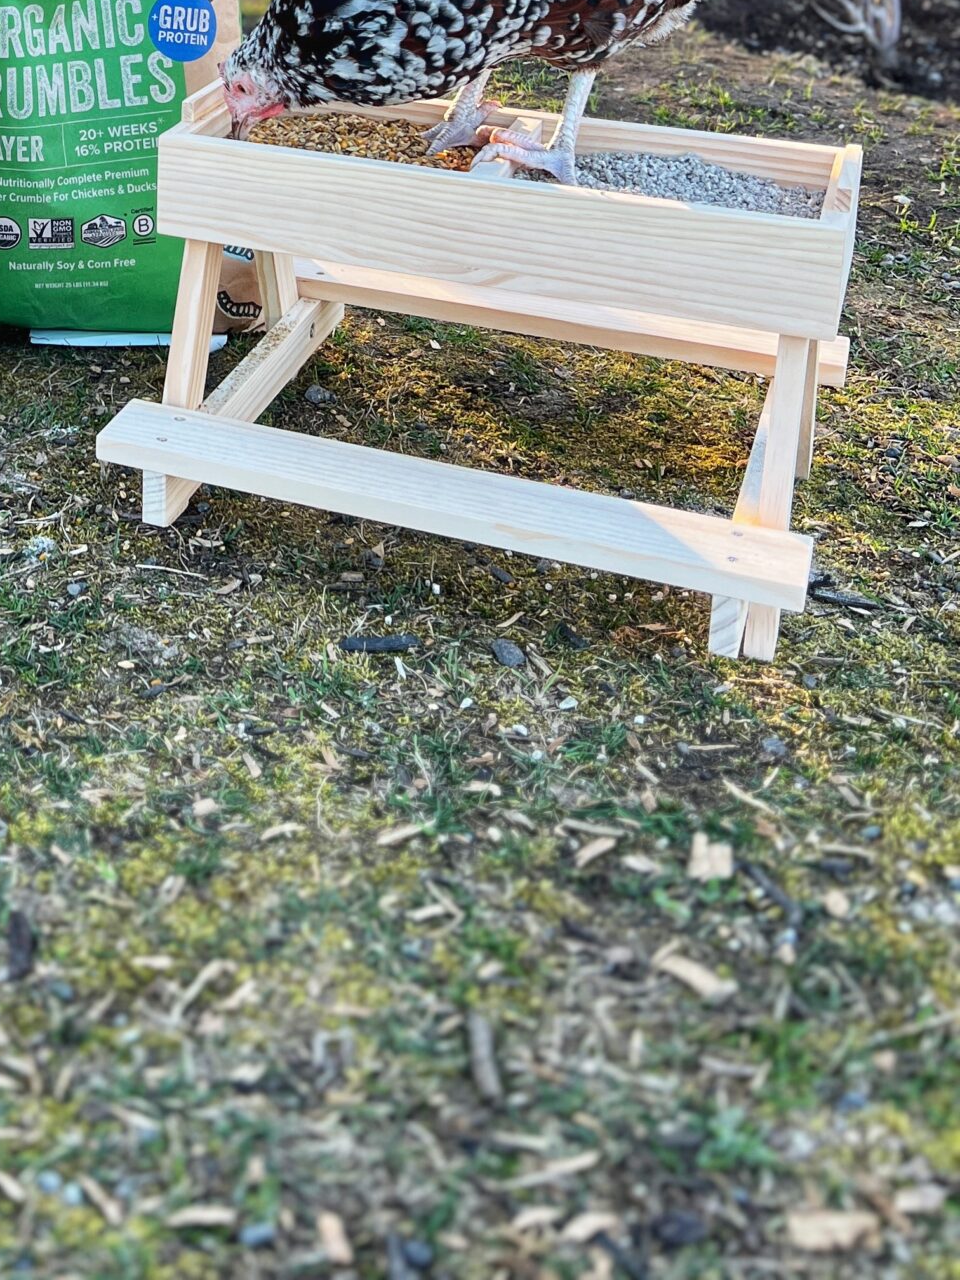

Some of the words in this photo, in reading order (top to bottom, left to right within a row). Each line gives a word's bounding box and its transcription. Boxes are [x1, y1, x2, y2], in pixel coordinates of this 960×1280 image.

[157, 31, 208, 46] PROTEIN
[79, 129, 105, 142] 20+
[75, 143, 101, 158] 16%
[104, 137, 159, 154] PROTEI
[57, 171, 102, 187] Complete
[104, 167, 149, 181] Premium
[9, 192, 52, 203] Crumble
[53, 191, 69, 202] For
[71, 185, 115, 200] Chickens
[117, 184, 125, 194] &
[127, 182, 157, 194] Ducks
[137, 218, 149, 232] B
[8, 261, 55, 272] Naturally
[56, 261, 75, 271] Soy
[78, 260, 85, 269] &
[87, 259, 111, 269] Corn
[113, 258, 136, 268] Free
